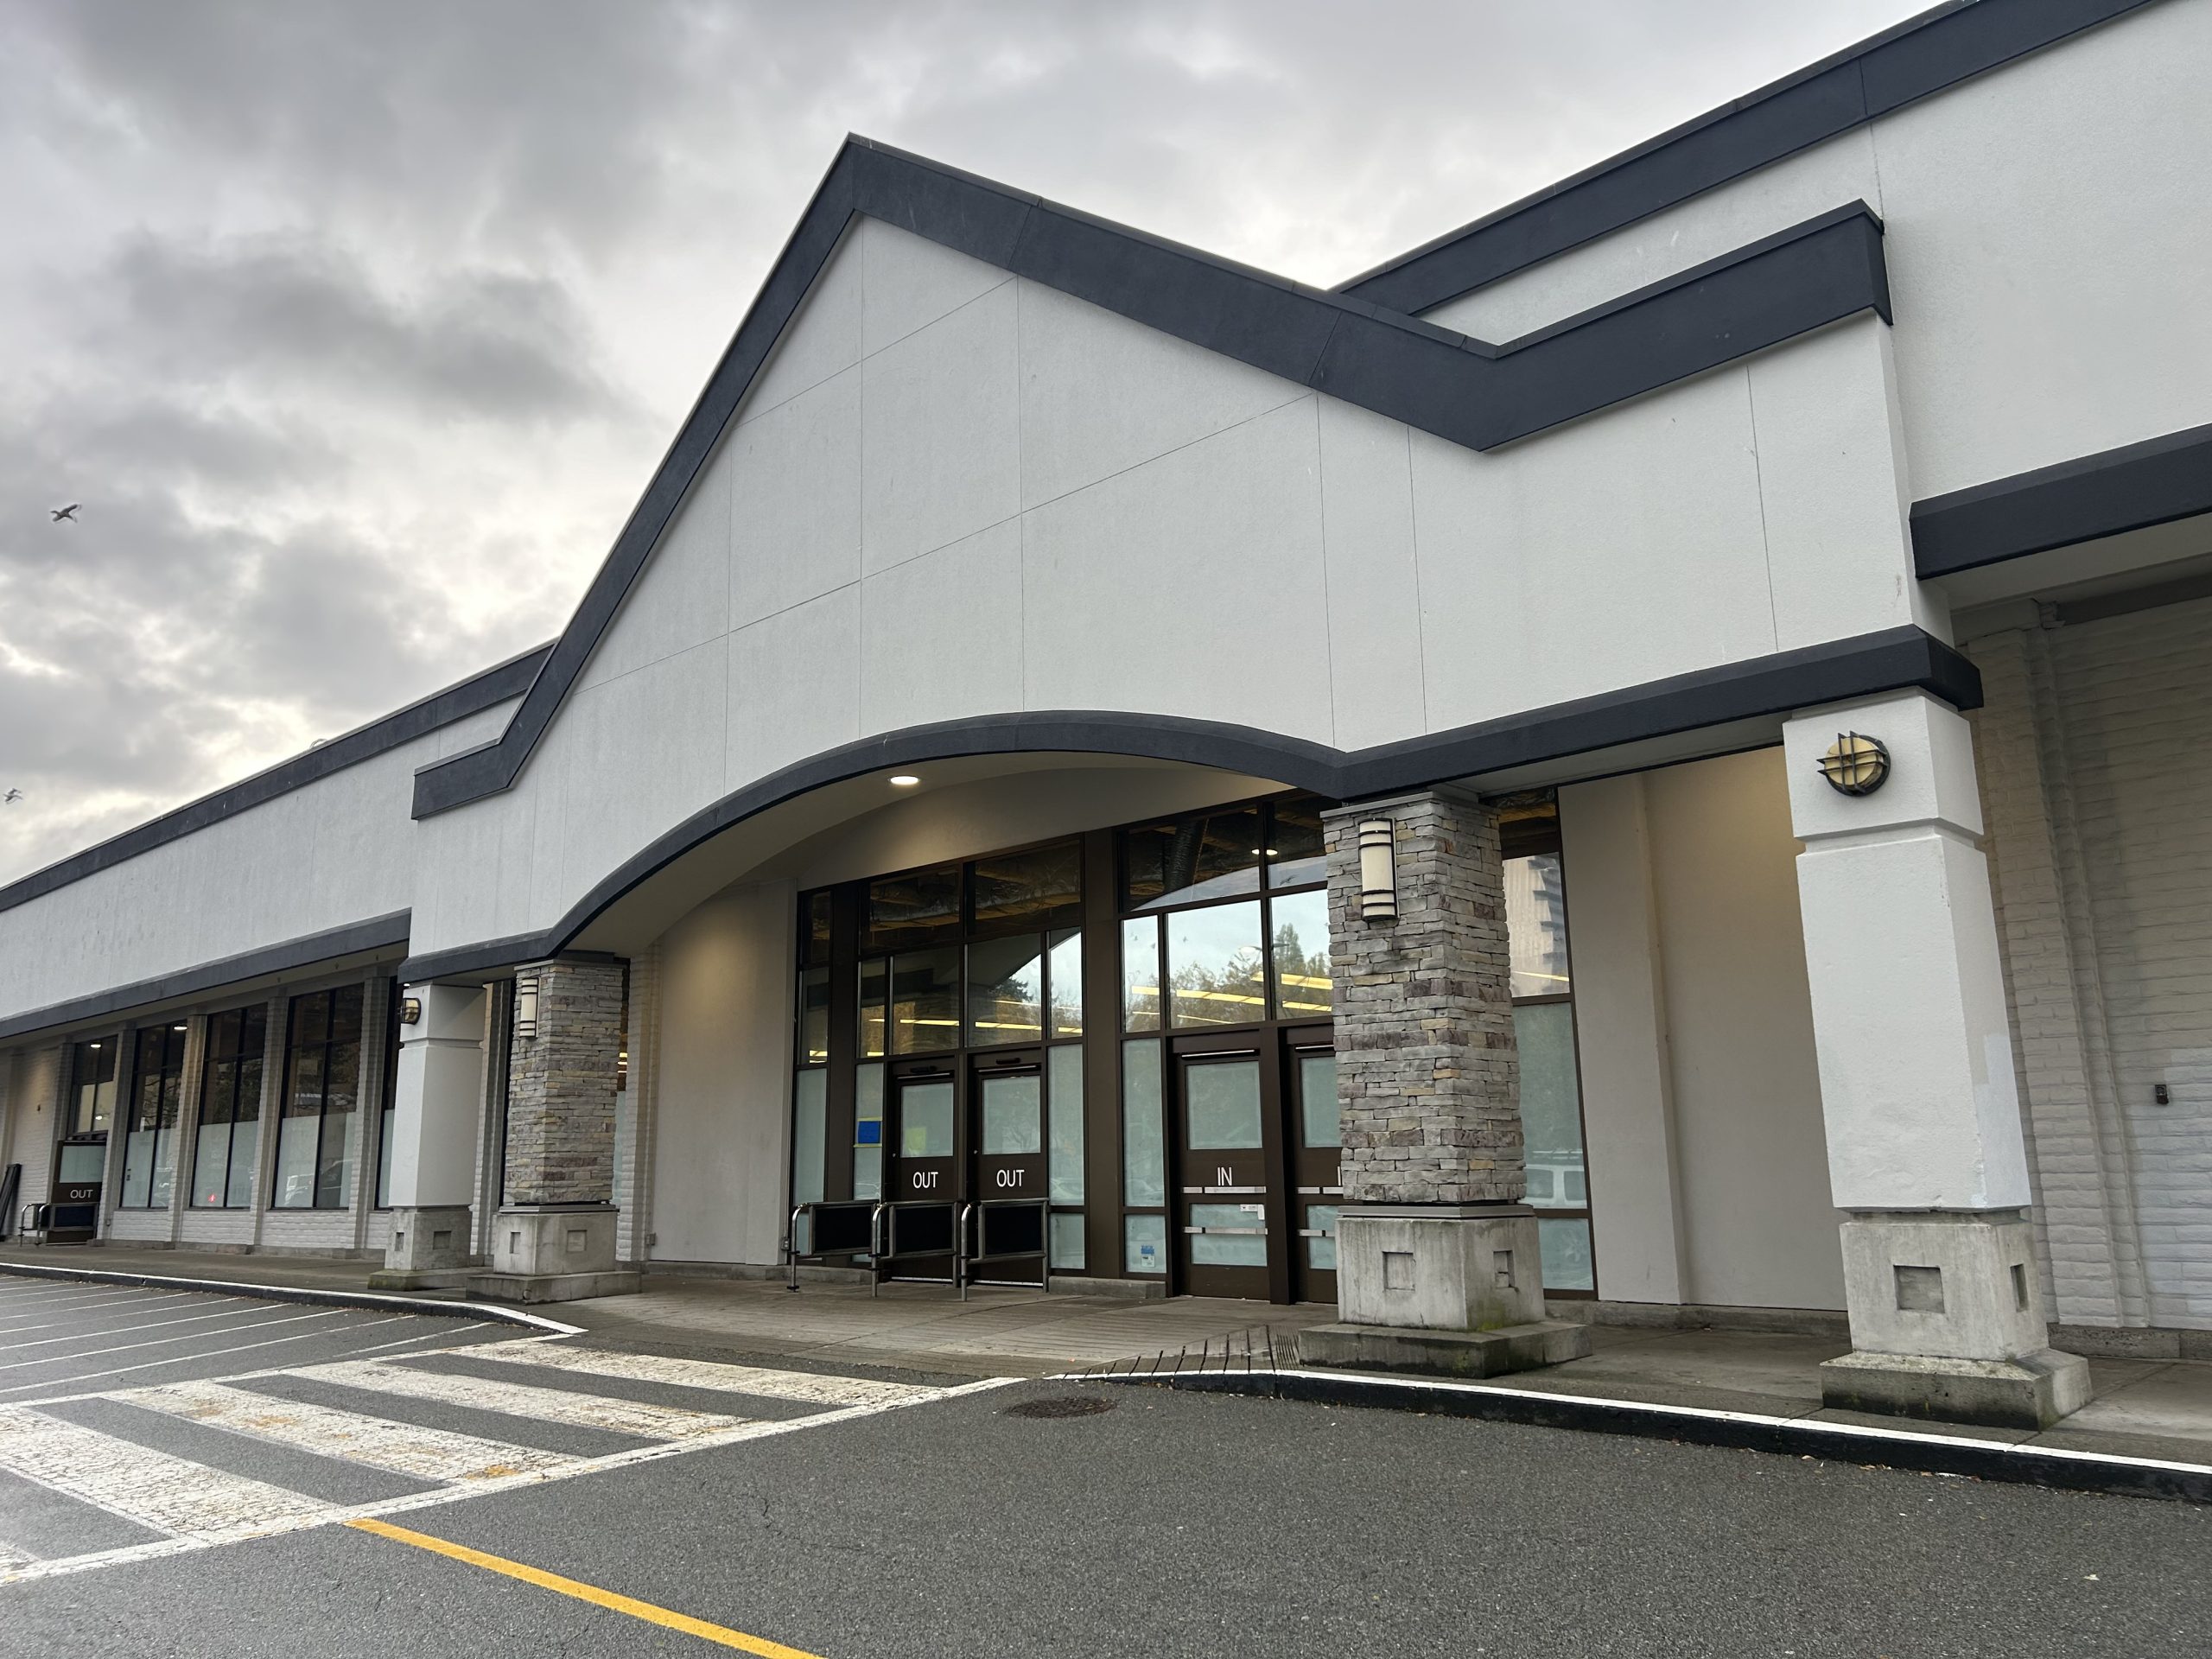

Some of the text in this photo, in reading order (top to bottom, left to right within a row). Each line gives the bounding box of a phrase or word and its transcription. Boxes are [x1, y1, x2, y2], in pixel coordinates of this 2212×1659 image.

[912, 1171, 939, 1189] OUT
[996, 1169, 1025, 1188] OUT
[1217, 1166, 1232, 1186] IN
[69, 1188, 93, 1199] OUT
